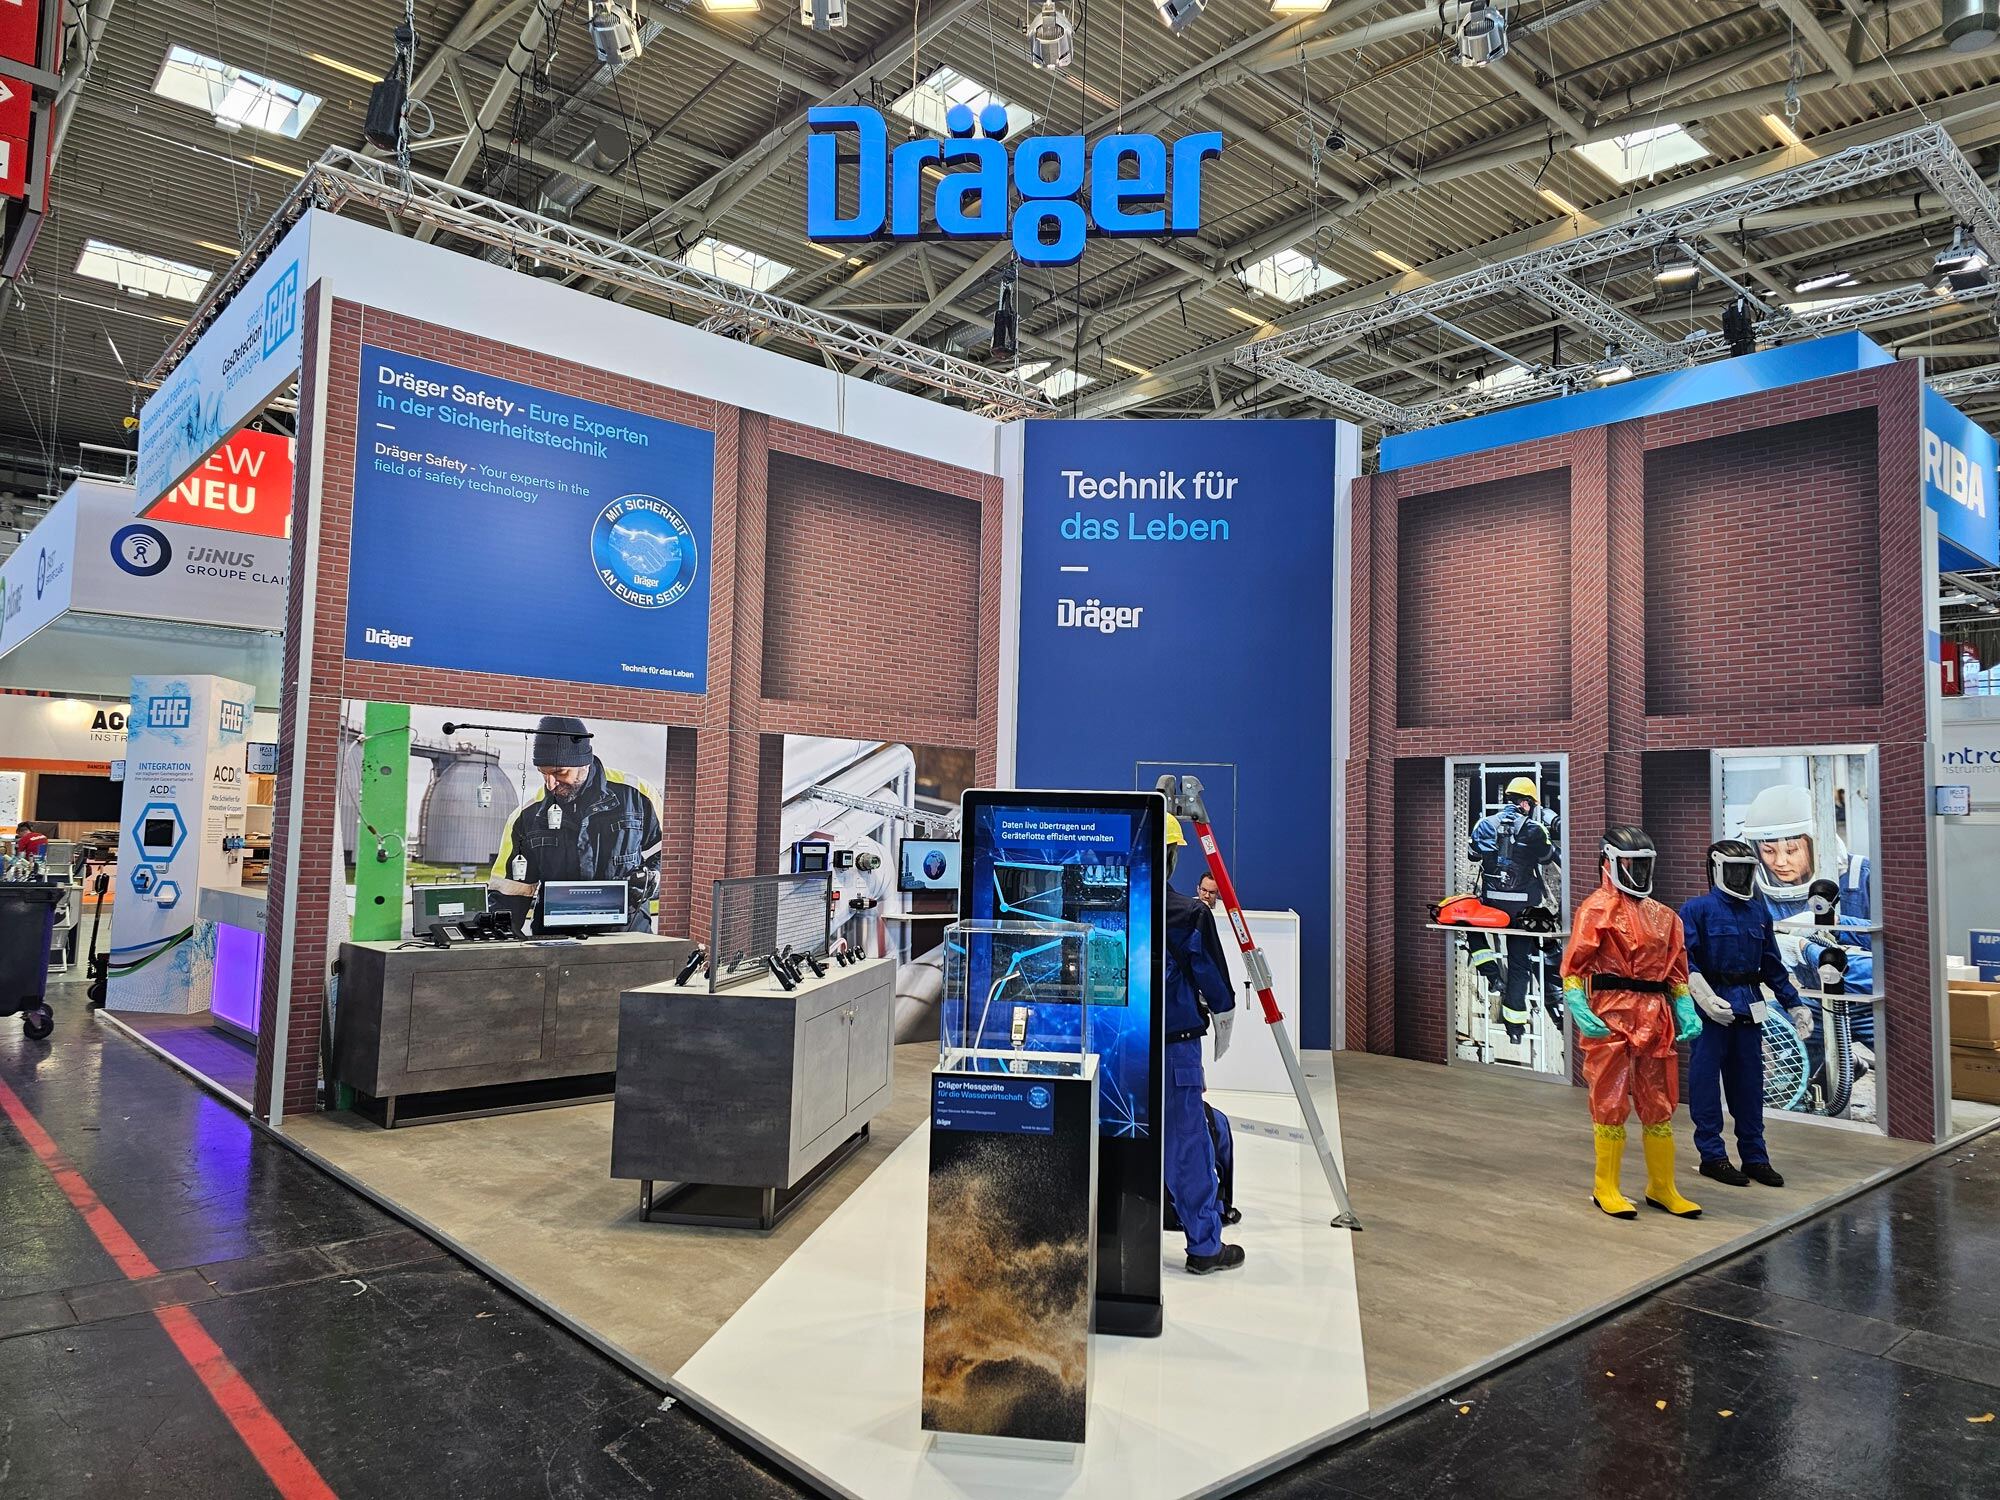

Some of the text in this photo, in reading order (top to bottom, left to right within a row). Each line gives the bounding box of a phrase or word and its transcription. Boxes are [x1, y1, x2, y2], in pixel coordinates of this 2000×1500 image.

[808, 104, 1223, 264] Dräger
[222, 324, 262, 376] GasDetection
[226, 347, 262, 392] Technologies
[379, 365, 448, 397] Dräger
[452, 384, 514, 417] Safety
[529, 403, 569, 428] Eure
[573, 414, 648, 447] Experten
[377, 390, 608, 459] in der Sicherheitstechnik
[374, 459, 539, 503] field of safety technology
[375, 442, 422, 463] Dräger
[425, 452, 467, 474] Safety
[479, 463, 507, 481] Your
[510, 472, 555, 490] experts
[558, 479, 569, 493] in
[571, 483, 591, 497] the
[168, 477, 256, 515] NEU
[1061, 470, 1239, 500] Technik für
[605, 499, 689, 536] MIT SICHERHEIT
[1060, 511, 1230, 541] das Leben
[185, 564, 247, 581] GROUPE
[601, 568, 686, 605] AN EURER SEITE
[633, 574, 659, 588] Dräger
[1057, 598, 1144, 634] Dräger
[365, 627, 414, 649] Dräger
[621, 663, 695, 679] Technik für das Leben
[91, 710, 128, 730] AC
[138, 762, 191, 771] INTEGRATION
[1001, 831, 1114, 842] Geräteflotte effizient verwalten
[1002, 821, 1096, 832] Daten live übertragen und
[938, 1081, 1005, 1092] Dräger Messgeräte
[938, 1089, 1023, 1101] für die Wasserwirtschaft
